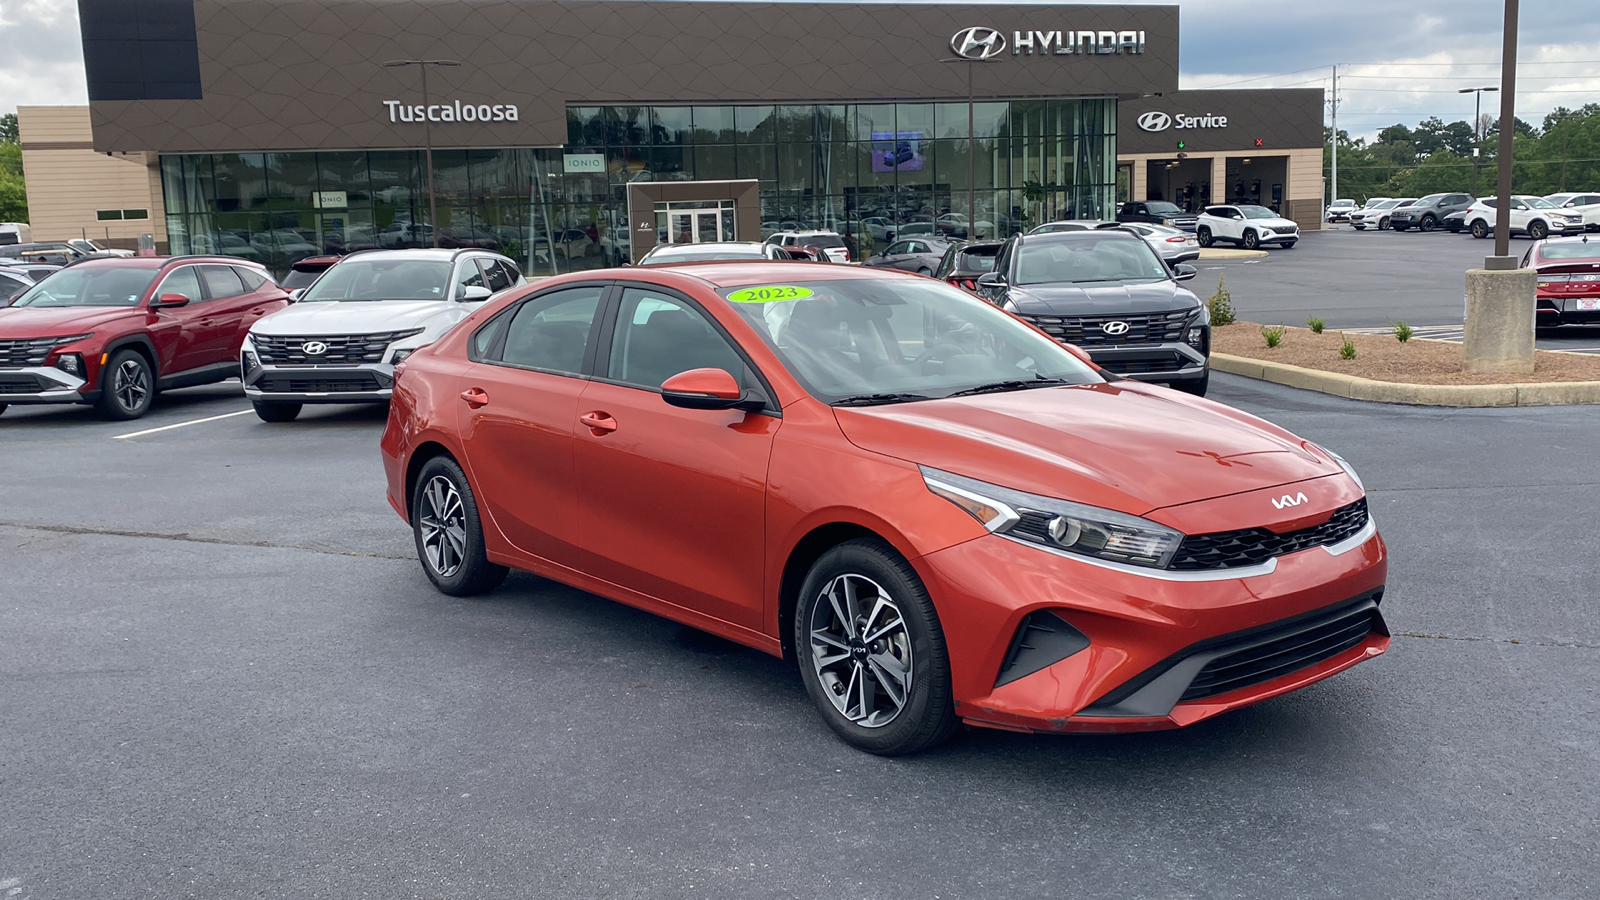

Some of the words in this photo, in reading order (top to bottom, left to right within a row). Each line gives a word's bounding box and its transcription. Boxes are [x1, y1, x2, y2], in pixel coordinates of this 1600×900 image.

[1012, 30, 1146, 55] HYUNDAI
[382, 99, 519, 123] Tuscaloosa
[1175, 113, 1227, 128] Service
[745, 287, 798, 301] 2023
[1271, 491, 1309, 510] KIA
